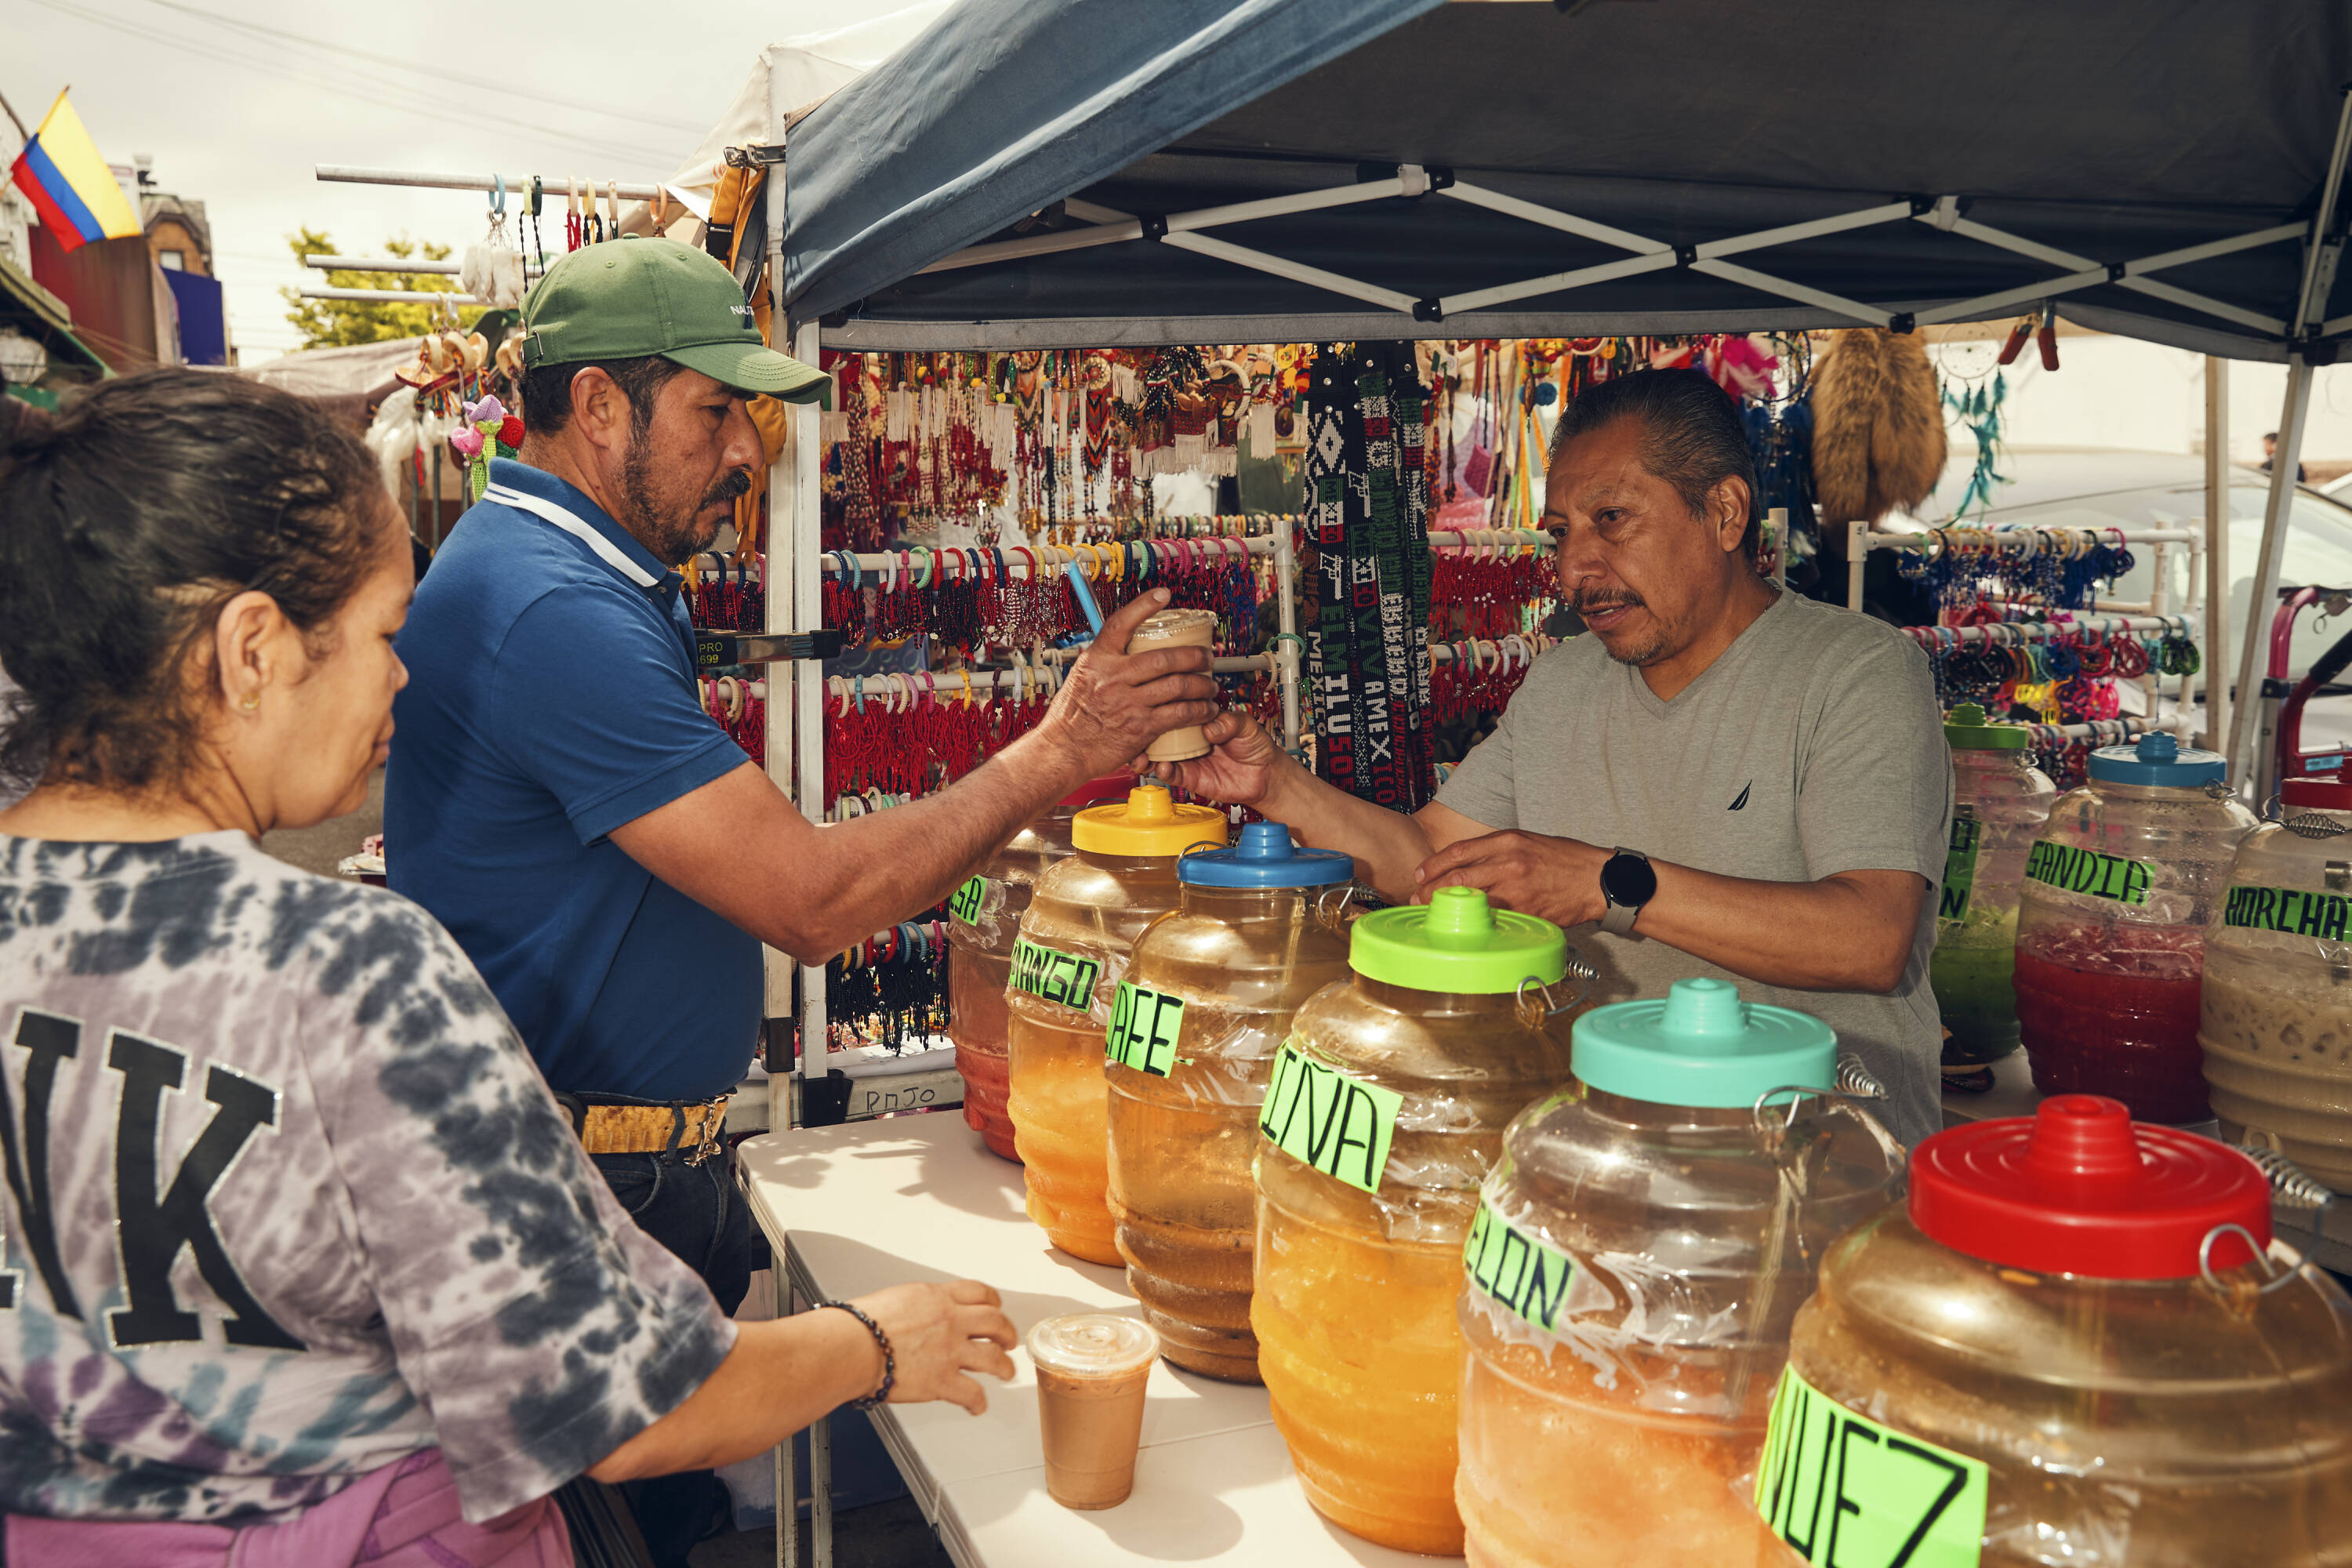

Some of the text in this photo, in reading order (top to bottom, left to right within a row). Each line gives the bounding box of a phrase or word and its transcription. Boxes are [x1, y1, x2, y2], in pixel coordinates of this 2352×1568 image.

[697, 654, 719, 664] 699
[699, 641, 723, 653] PRO
[1308, 630, 1327, 738] MEXICO
[950, 877, 982, 922] SA
[2027, 840, 2148, 906] SANDIA
[2225, 887, 2352, 942] HORCHA
[1011, 939, 1098, 1010] MANGO
[1105, 985, 1184, 1077] AFE
